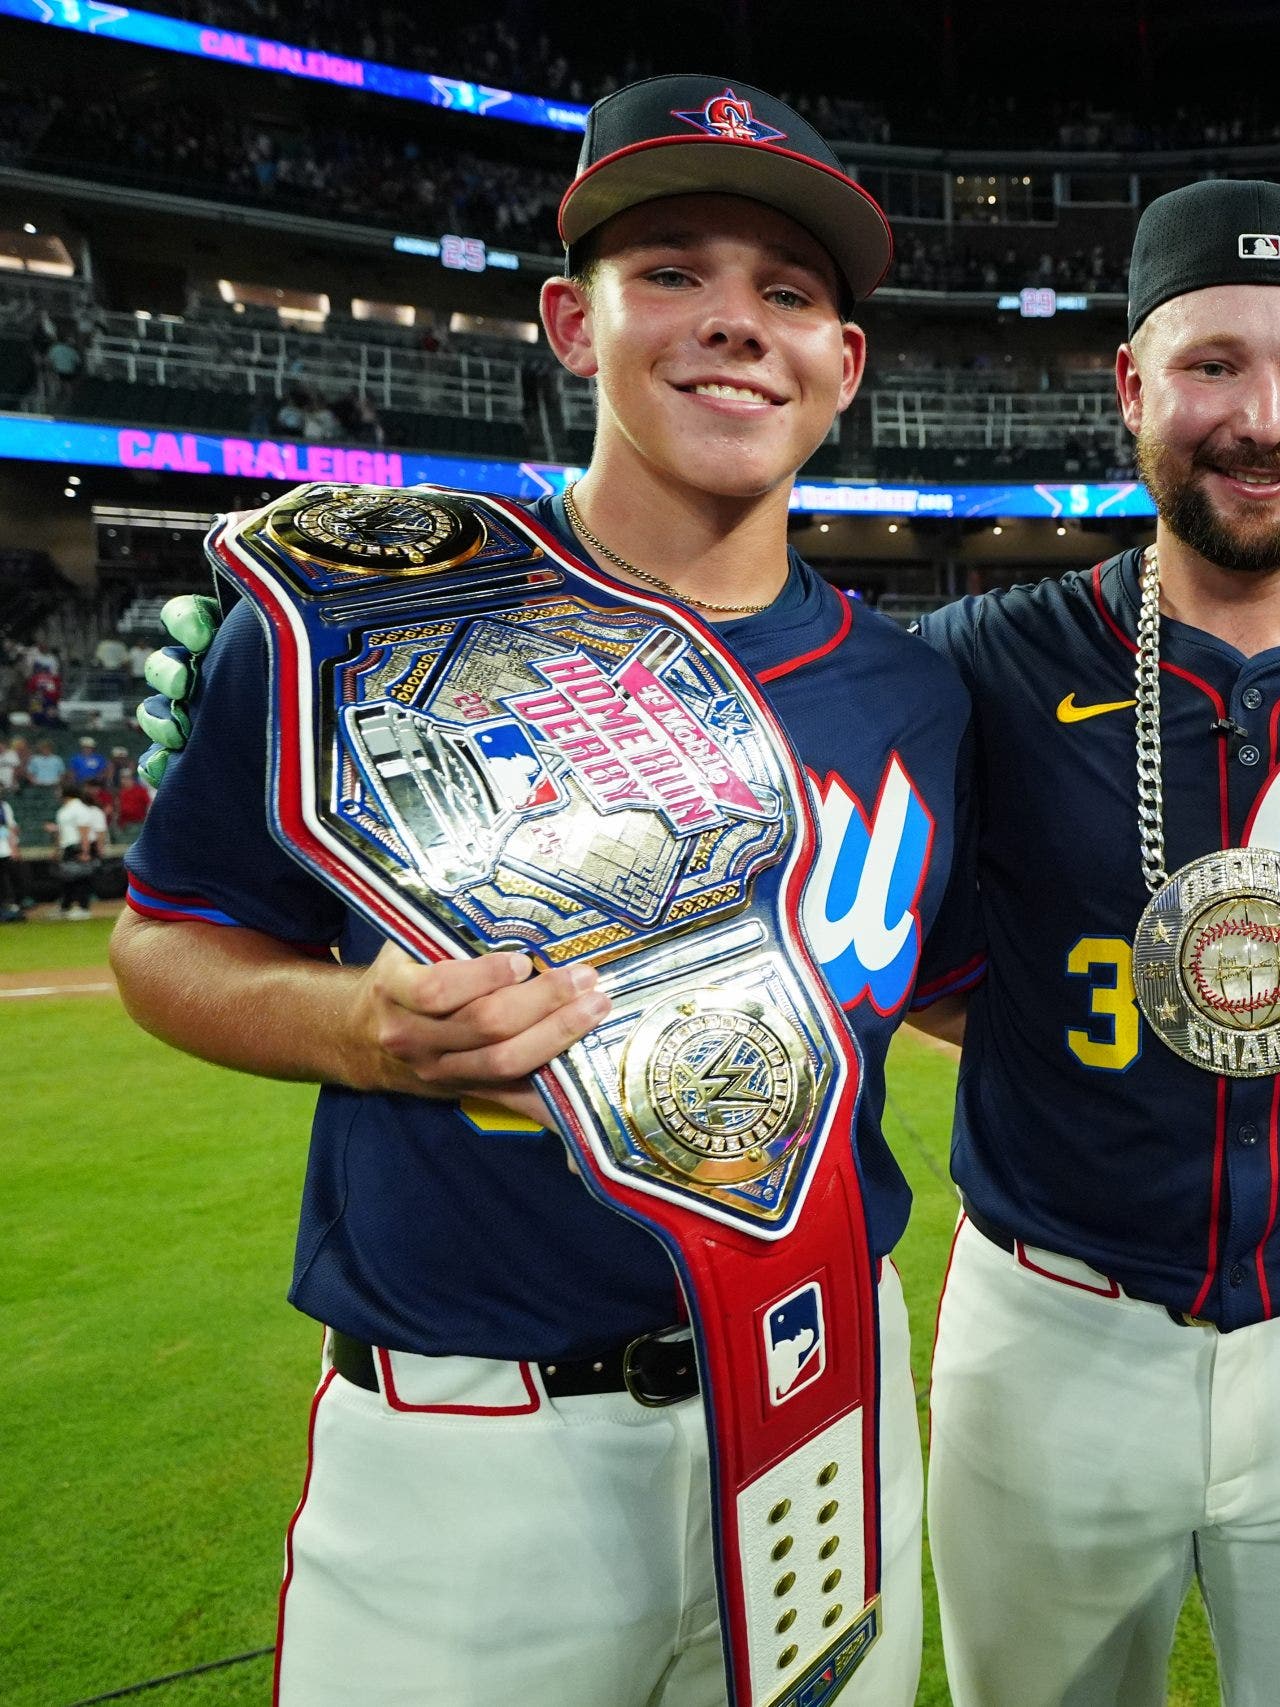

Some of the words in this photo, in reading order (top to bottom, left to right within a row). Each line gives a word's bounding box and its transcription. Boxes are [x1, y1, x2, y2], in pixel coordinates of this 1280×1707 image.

[201, 29, 254, 64] CAL
[258, 40, 364, 87] RALEIGH
[440, 234, 486, 272] 25
[1020, 288, 1056, 317] 29
[118, 428, 211, 473] CAL
[223, 438, 404, 487] RALEIGH
[453, 692, 489, 720] 20
[511, 693, 649, 803] DERBY
[541, 656, 666, 751] HOME
[628, 748, 717, 826] RUN
[1064, 934, 1142, 1074] 3
